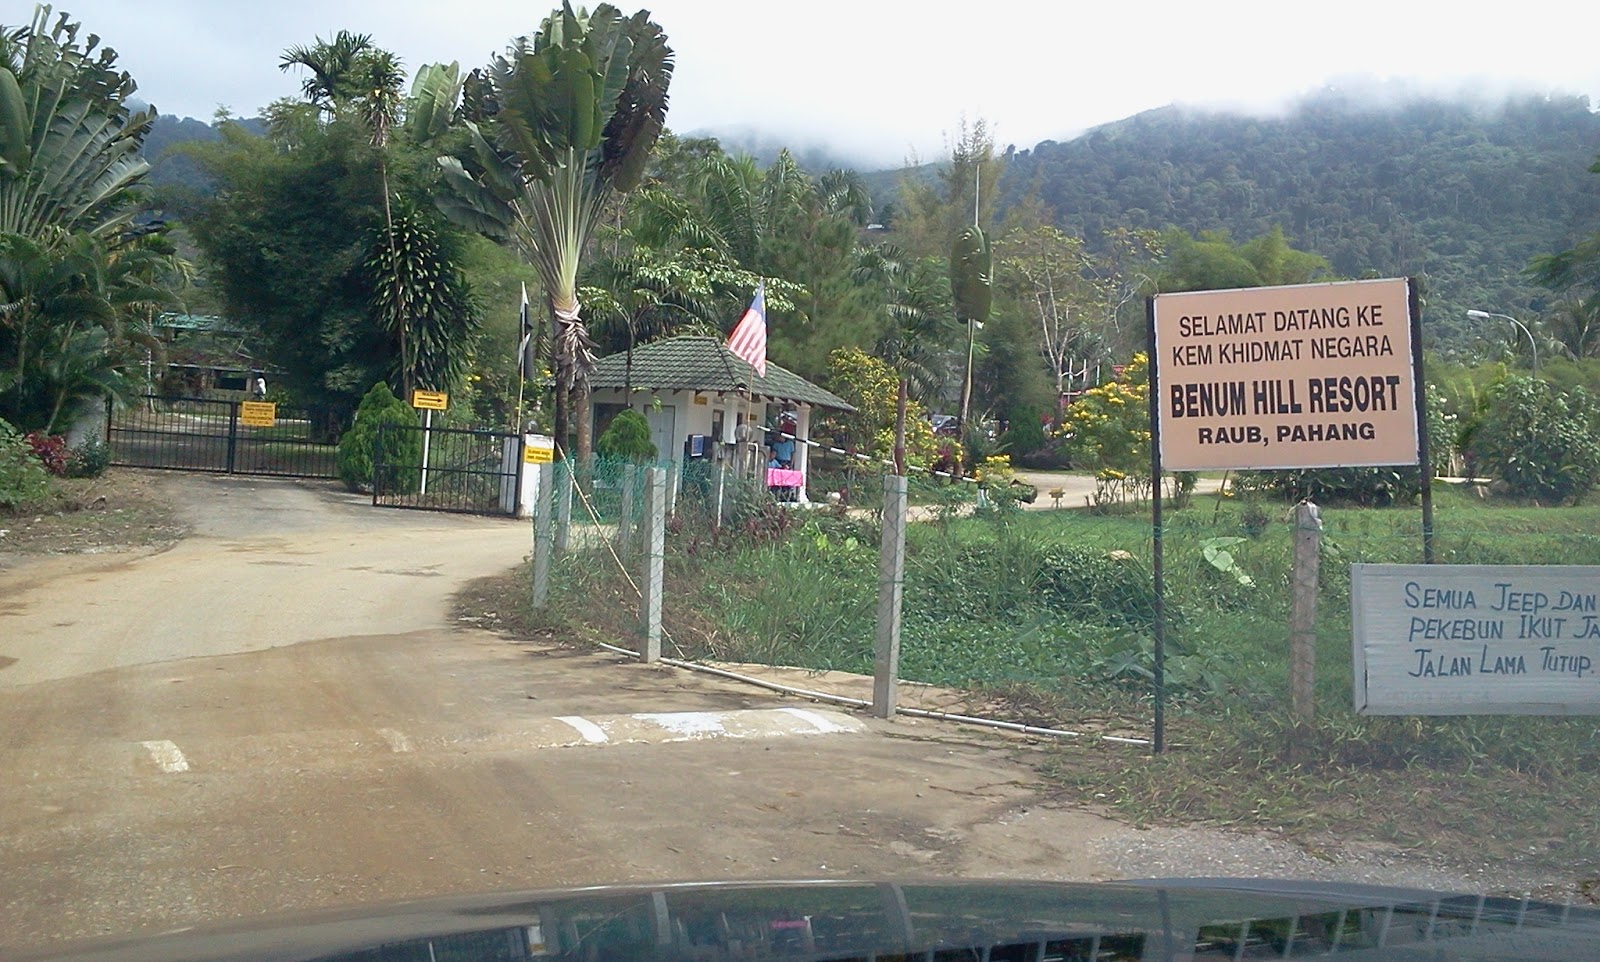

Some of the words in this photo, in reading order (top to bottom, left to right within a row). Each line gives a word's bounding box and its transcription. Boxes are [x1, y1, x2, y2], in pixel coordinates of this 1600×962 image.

[1179, 312, 1267, 338] SELAMAT
[1274, 307, 1350, 332] DATANG
[1356, 305, 1383, 327] KE
[1173, 345, 1213, 366] KEM
[1219, 340, 1303, 364] KHIDMAT
[1311, 335, 1394, 359] NEGARA
[1170, 381, 1247, 418] BENUM
[1252, 379, 1302, 416] HILL
[1308, 375, 1400, 413] RESORT
[1198, 426, 1269, 446] RAUB,
[1276, 422, 1376, 442] PAHANG
[1404, 581, 1476, 610] SEMUA
[1490, 583, 1549, 615] JEEP
[1551, 591, 1596, 612] DAN
[1408, 617, 1504, 642] PEKEBUN
[1518, 614, 1567, 639] IKUT
[1408, 648, 1471, 678] JALAN
[1479, 644, 1527, 675] LAMA
